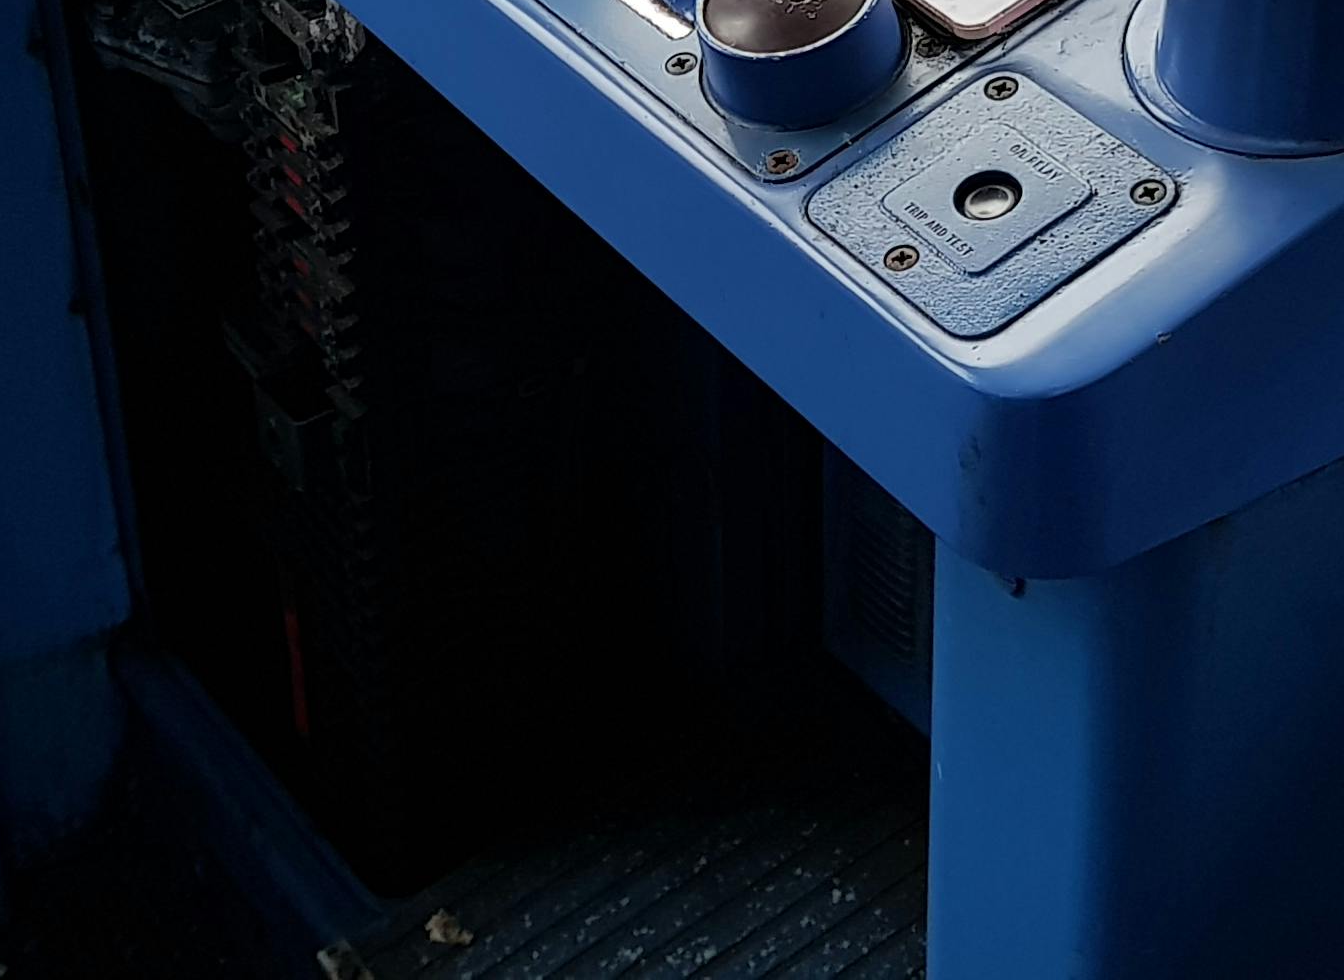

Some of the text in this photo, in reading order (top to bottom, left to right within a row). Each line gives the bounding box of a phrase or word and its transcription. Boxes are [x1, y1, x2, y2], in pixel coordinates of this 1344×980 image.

[904, 202, 975, 256] TRIP AND TEST
